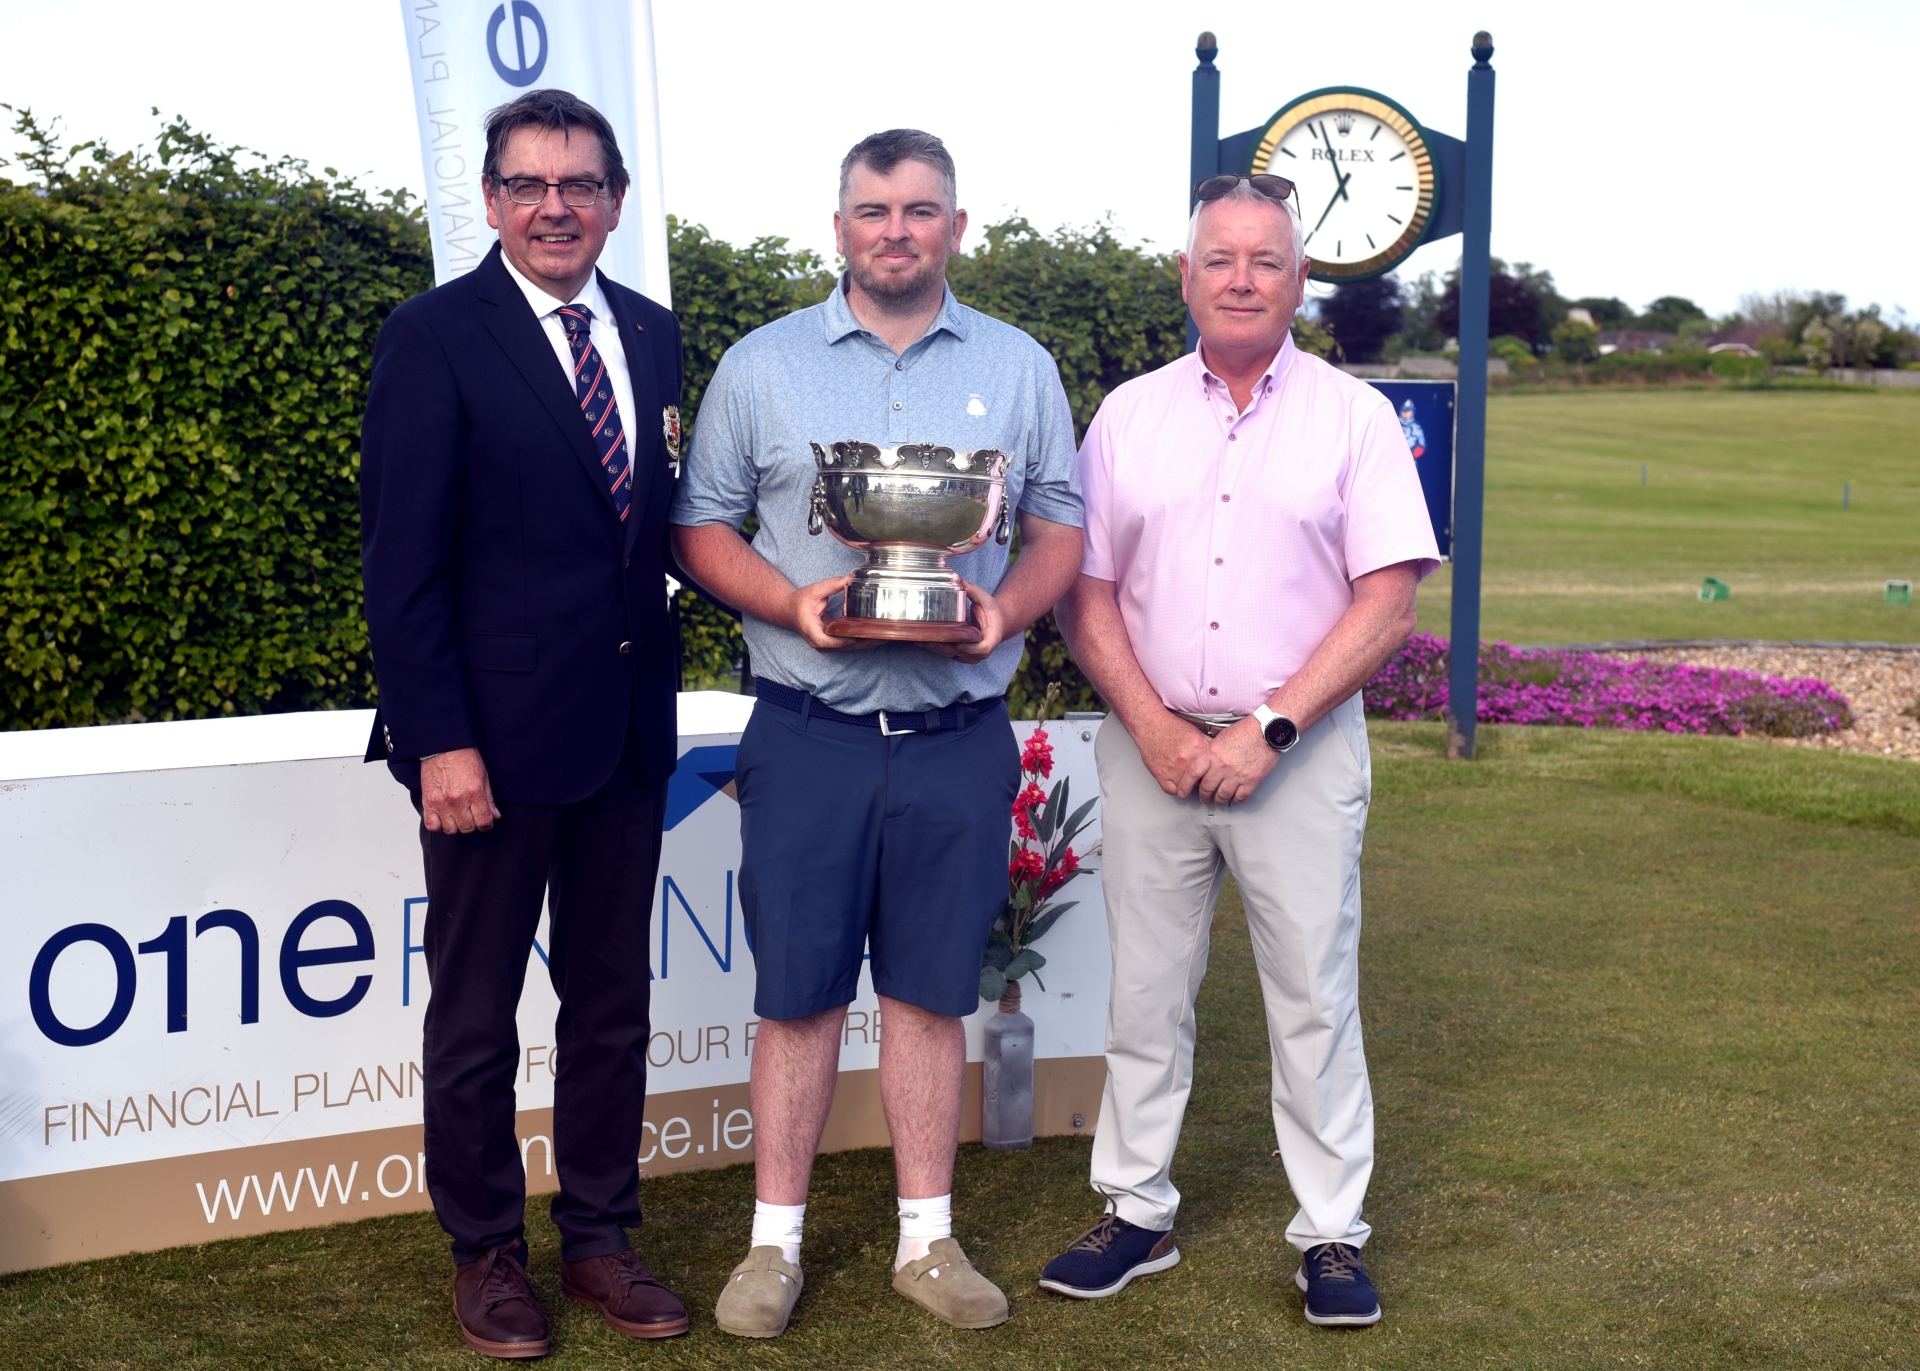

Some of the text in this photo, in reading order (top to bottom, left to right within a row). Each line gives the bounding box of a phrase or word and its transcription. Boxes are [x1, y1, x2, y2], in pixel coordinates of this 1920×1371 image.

[1311, 148, 1375, 162] ROLEX
[44, 1080, 279, 1146] FINANCIAL
[294, 1061, 424, 1112] PLANN
[646, 1025, 730, 1068] OUR
